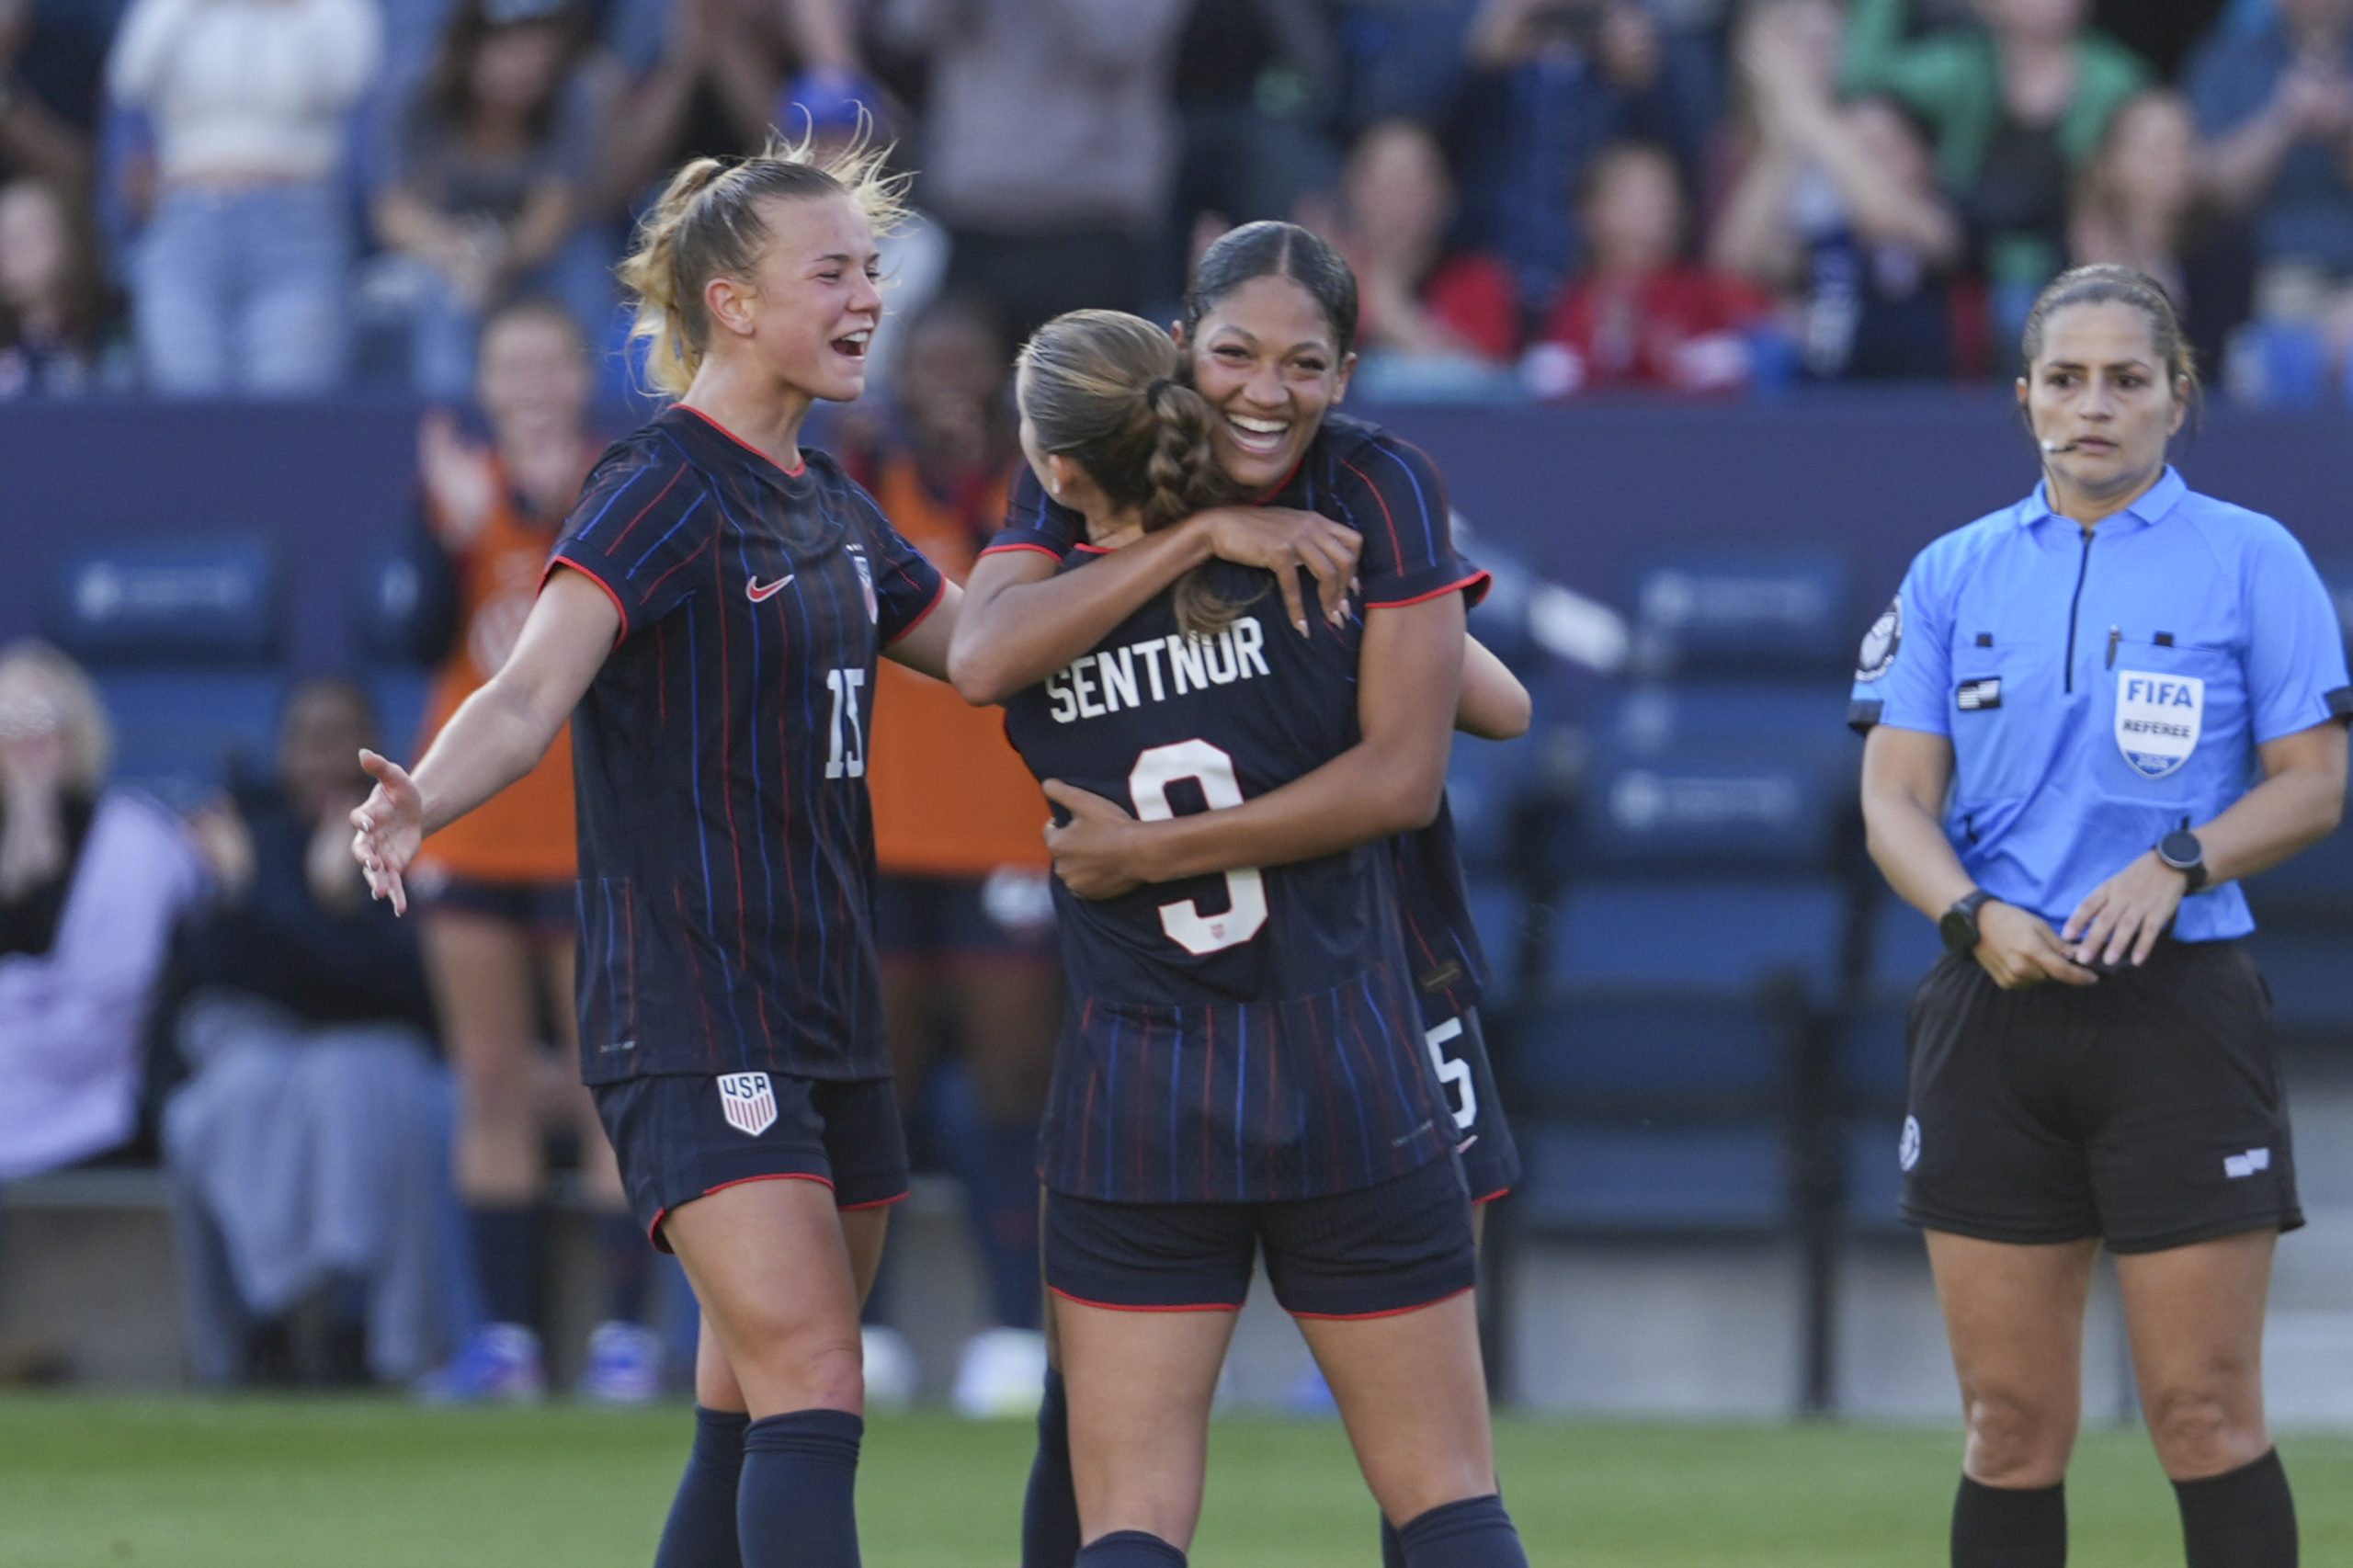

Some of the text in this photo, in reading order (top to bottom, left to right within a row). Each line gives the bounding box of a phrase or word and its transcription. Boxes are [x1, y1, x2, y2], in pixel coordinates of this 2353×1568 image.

[825, 668, 864, 778] 15
[1045, 616, 1270, 723] SENTNOR
[2126, 678, 2193, 709] FIFA
[2123, 719, 2191, 738] REFEREE
[1128, 738, 1268, 956] 9
[722, 1075, 767, 1099] USA
[1426, 1017, 1477, 1130] 5
